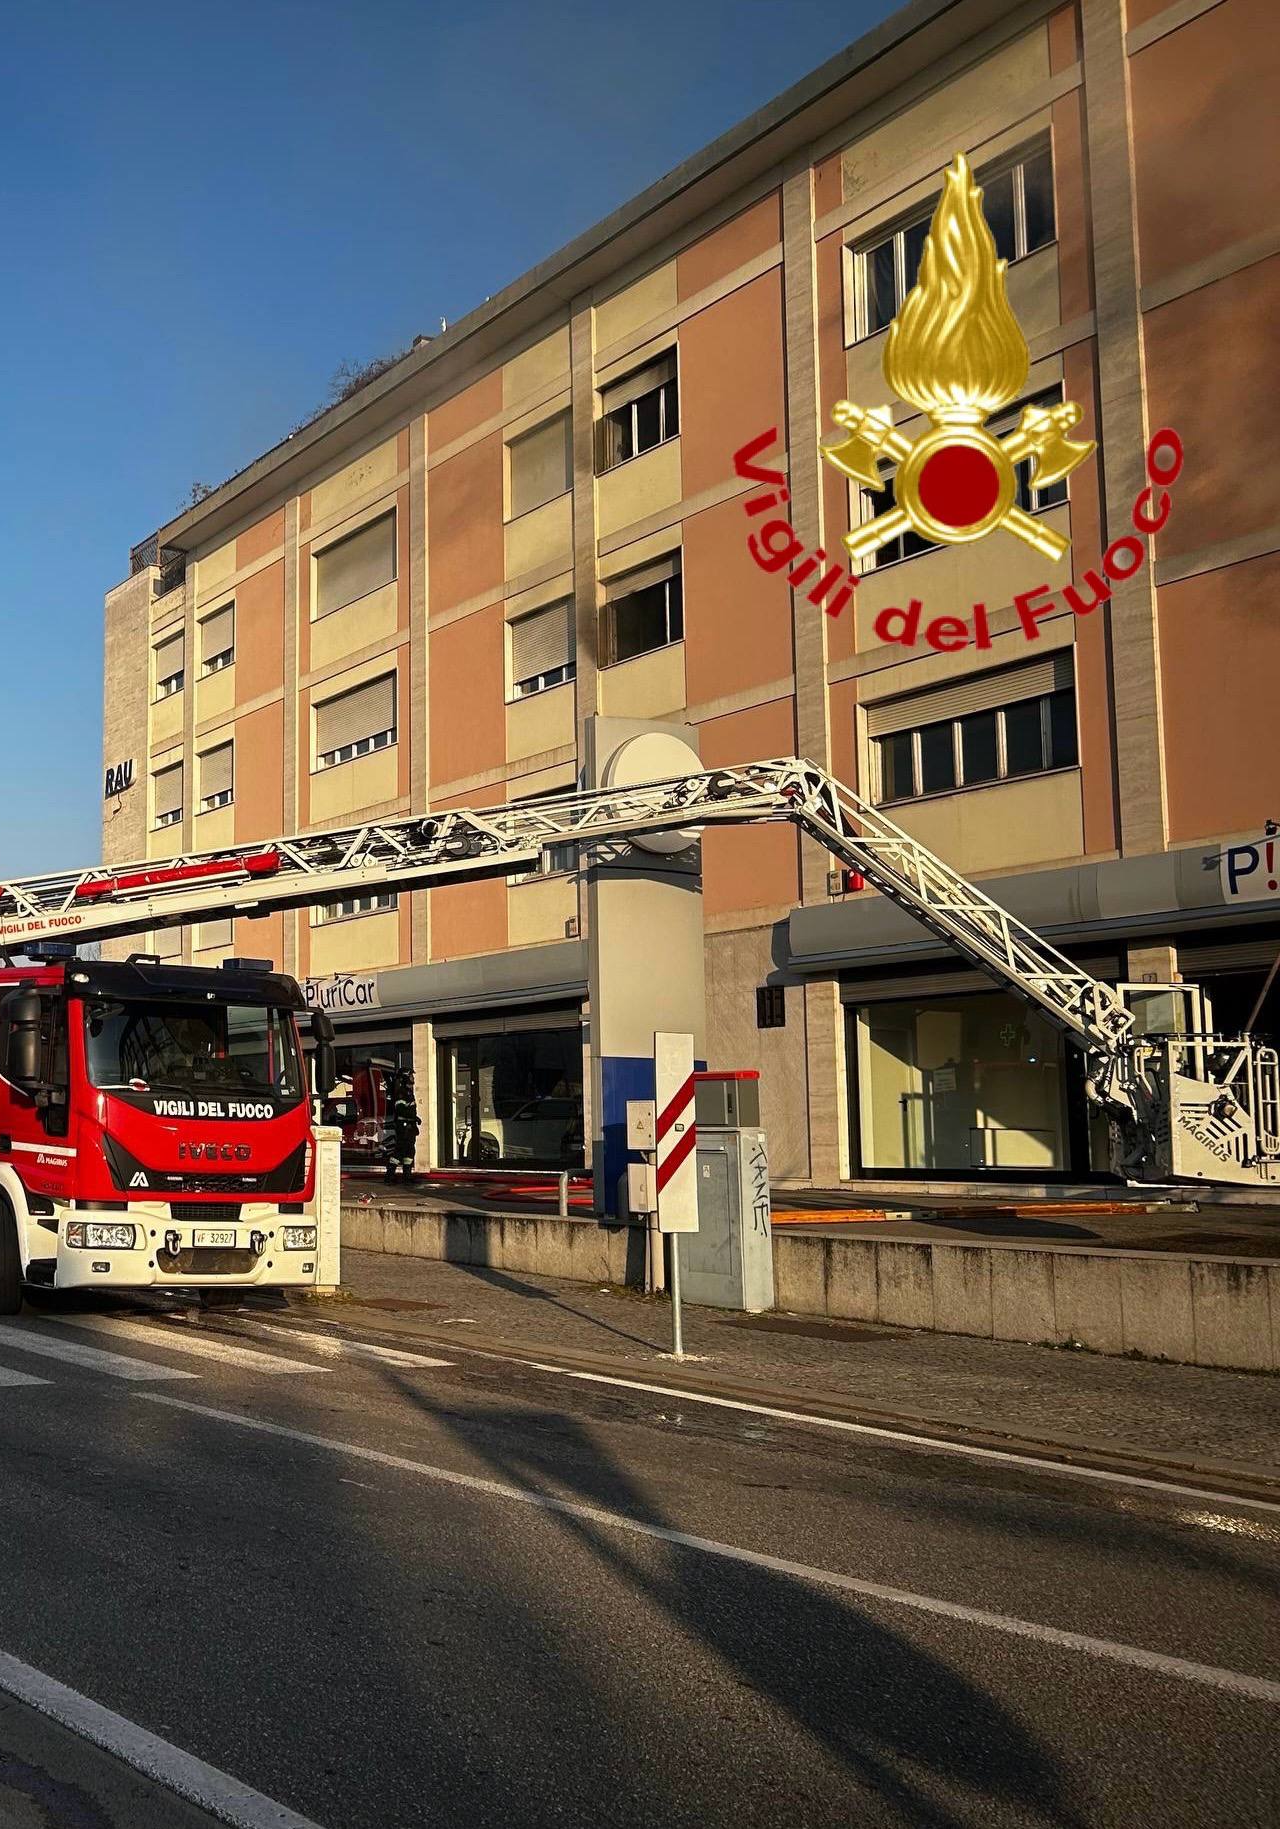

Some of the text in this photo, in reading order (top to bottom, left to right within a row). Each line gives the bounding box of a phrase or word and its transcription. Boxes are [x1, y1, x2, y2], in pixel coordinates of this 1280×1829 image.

[27, 920, 46, 931] DEL
[48, 914, 82, 927] FUOCO
[154, 1100, 274, 1119] VIGILI DEL FUOCO
[1177, 1115, 1231, 1163] MAGIRUS
[178, 1142, 251, 1161] IVECO
[45, 1157, 68, 1167] MAGIRUS
